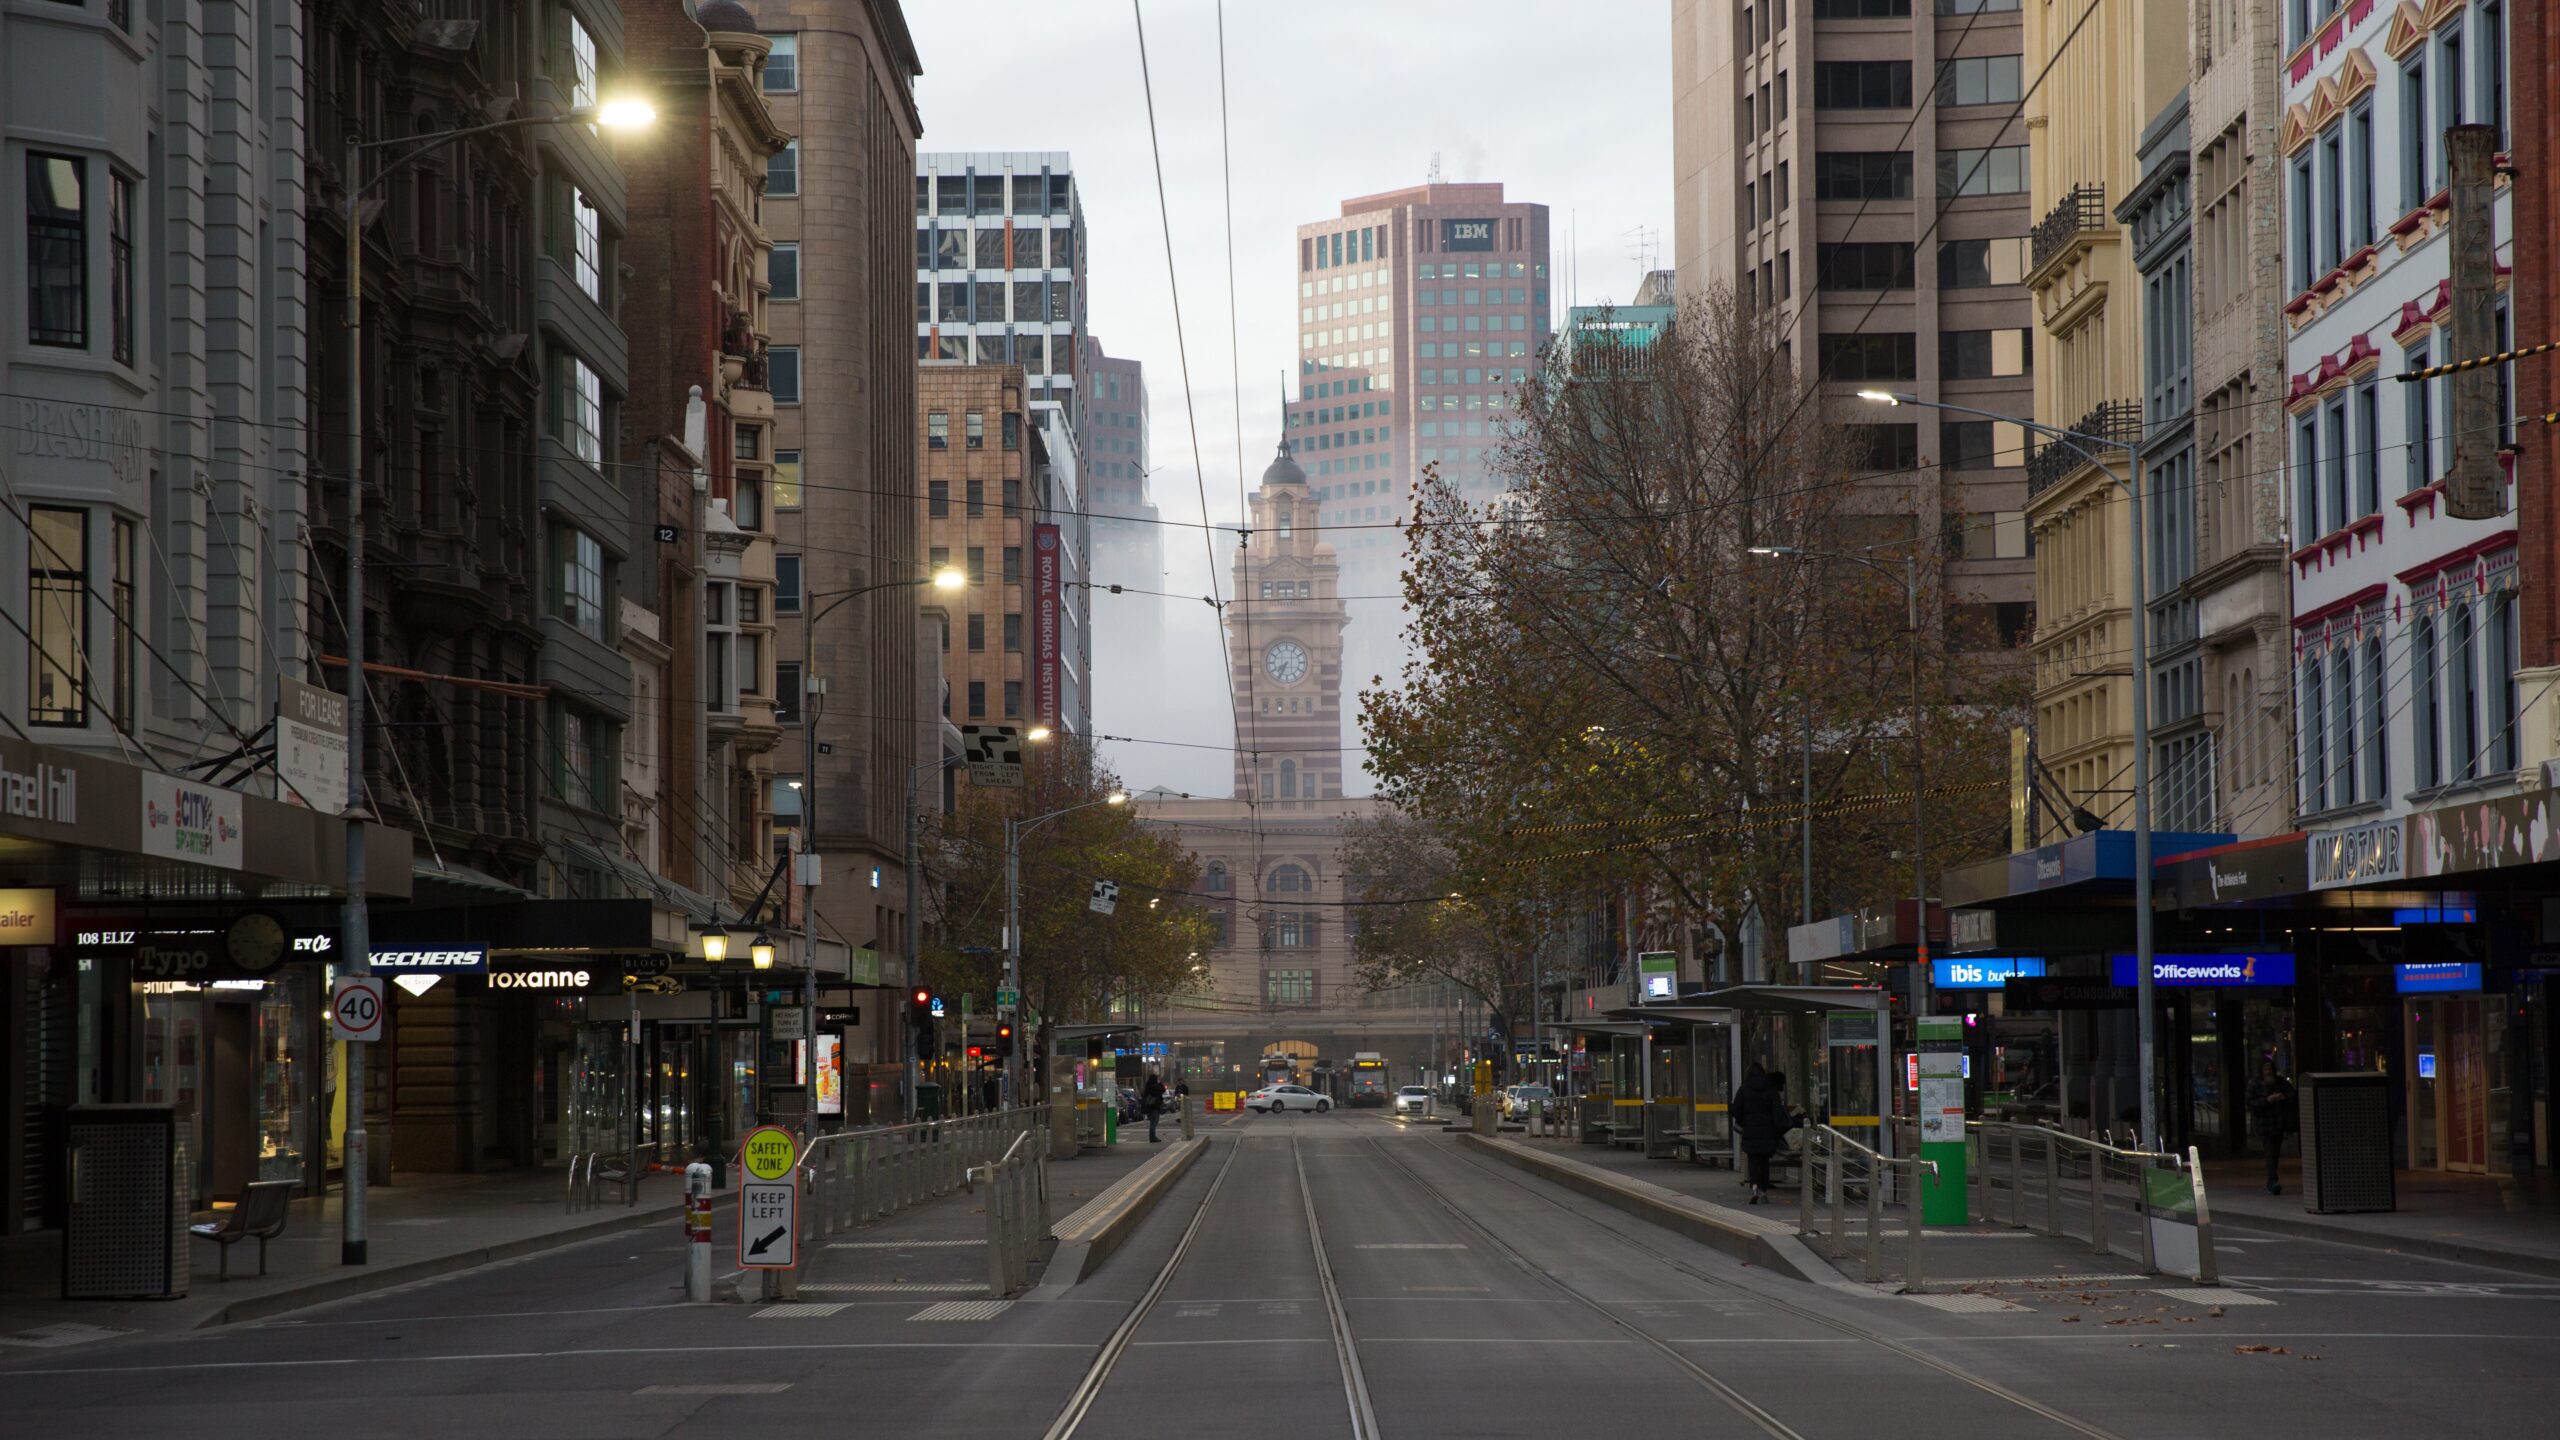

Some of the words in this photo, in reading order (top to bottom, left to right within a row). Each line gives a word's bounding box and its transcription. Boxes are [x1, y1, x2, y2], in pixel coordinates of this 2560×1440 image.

[1454, 223, 1489, 239] IBM
[660, 529, 674, 541] 12
[1041, 556, 1053, 596] ROYAL
[1041, 599, 1053, 660] GURKHAS
[1042, 663, 1054, 726] INSTITUTE
[300, 690, 316, 720] FOR
[317, 696, 342, 727] LEASE
[971, 764, 994, 772] RIGHT
[974, 770, 995, 778] FROM
[985, 777, 1012, 785] AHEAD
[48, 765, 77, 825] hill
[181, 791, 209, 830] CITY
[2314, 825, 2400, 884] MINOTAUR
[77, 931, 99, 945] 108
[101, 931, 136, 945] ELIZ
[138, 946, 209, 976] Typo
[368, 951, 483, 967] KECHERS
[624, 958, 666, 968] BLOCK
[488, 970, 591, 989] roxanne
[1950, 964, 1983, 983] ibis
[2153, 964, 2241, 979] Officeworks
[340, 997, 375, 1020] 40
[750, 1142, 789, 1155] SAFETY
[756, 1158, 783, 1171] ZONE
[751, 1192, 786, 1204] KEEP
[752, 1207, 784, 1219] LEFT
